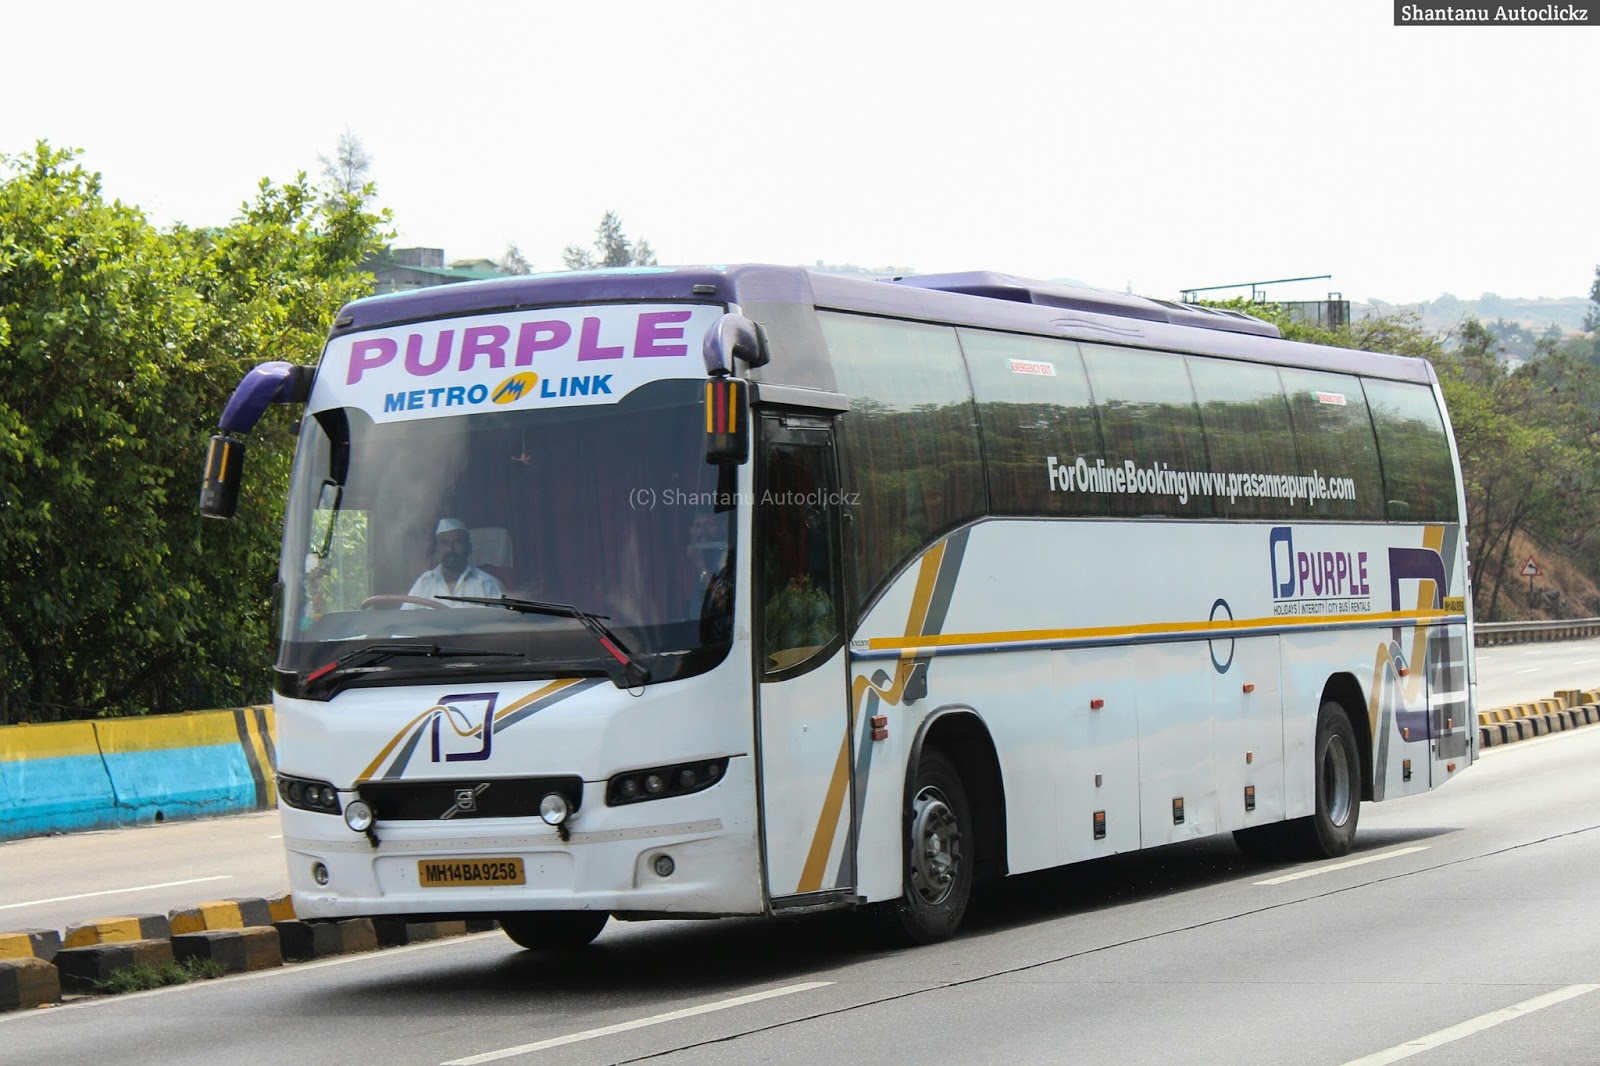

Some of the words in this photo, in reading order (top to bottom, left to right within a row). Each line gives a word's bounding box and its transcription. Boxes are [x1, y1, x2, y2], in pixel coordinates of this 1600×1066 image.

[347, 311, 692, 386] PURPLE
[384, 384, 488, 413] METRO
[540, 374, 613, 399] LINK
[1297, 551, 1370, 597] PURPLE
[1273, 604, 1297, 616] HOLIDAYS
[1301, 603, 1325, 614] INTERCITY
[1328, 602, 1338, 613] CITY
[1339, 601, 1348, 612] BUS
[1351, 601, 1370, 612] RENTALS
[425, 862, 517, 882] MH14BA9258
